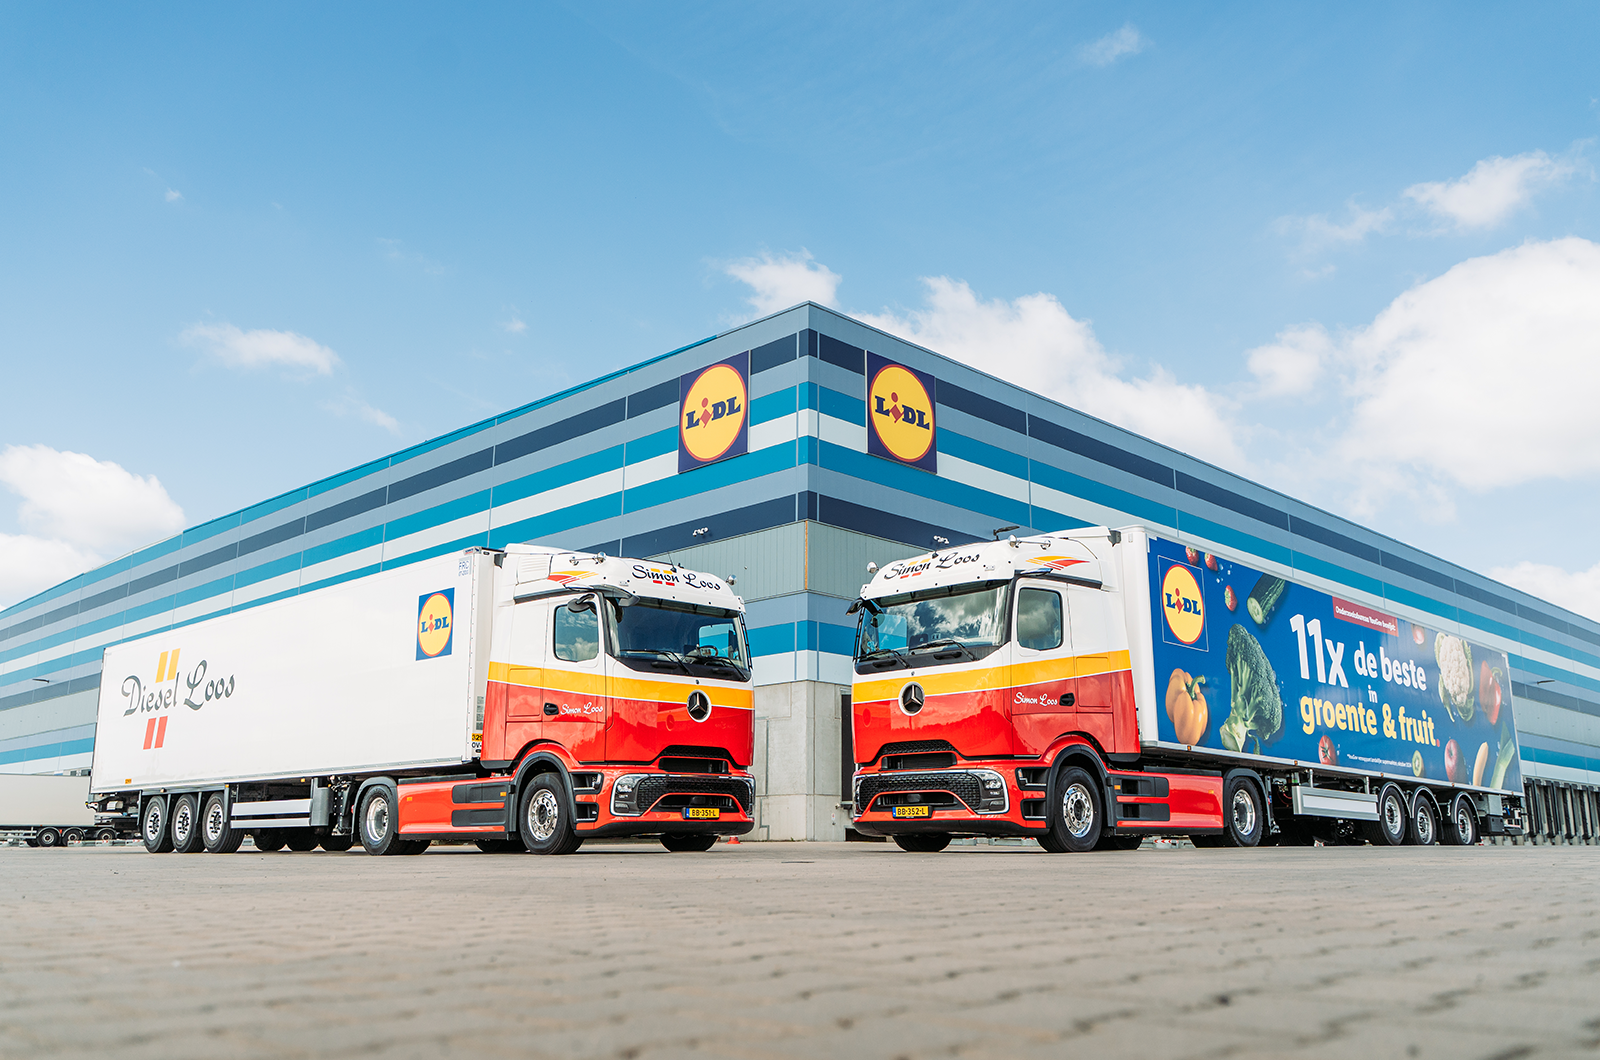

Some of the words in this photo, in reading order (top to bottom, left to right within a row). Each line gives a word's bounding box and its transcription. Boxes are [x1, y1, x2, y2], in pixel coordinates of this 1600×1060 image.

[632, 564, 680, 583] Simon
[683, 572, 721, 591] Loos
[884, 562, 931, 580] Simon
[935, 552, 980, 569] Loos
[1290, 613, 1349, 688] 11x
[1354, 641, 1378, 678] de
[1379, 646, 1427, 691] beste
[121, 671, 180, 717] Diesel
[183, 659, 235, 711] Loos
[1014, 692, 1038, 704] Simon
[1039, 693, 1057, 706] Loos
[1367, 685, 1378, 703] in
[560, 704, 581, 715] Simon
[583, 701, 603, 714] Loos
[1300, 695, 1378, 735] groente
[1382, 703, 1397, 739] &
[1399, 706, 1440, 747] fruit.
